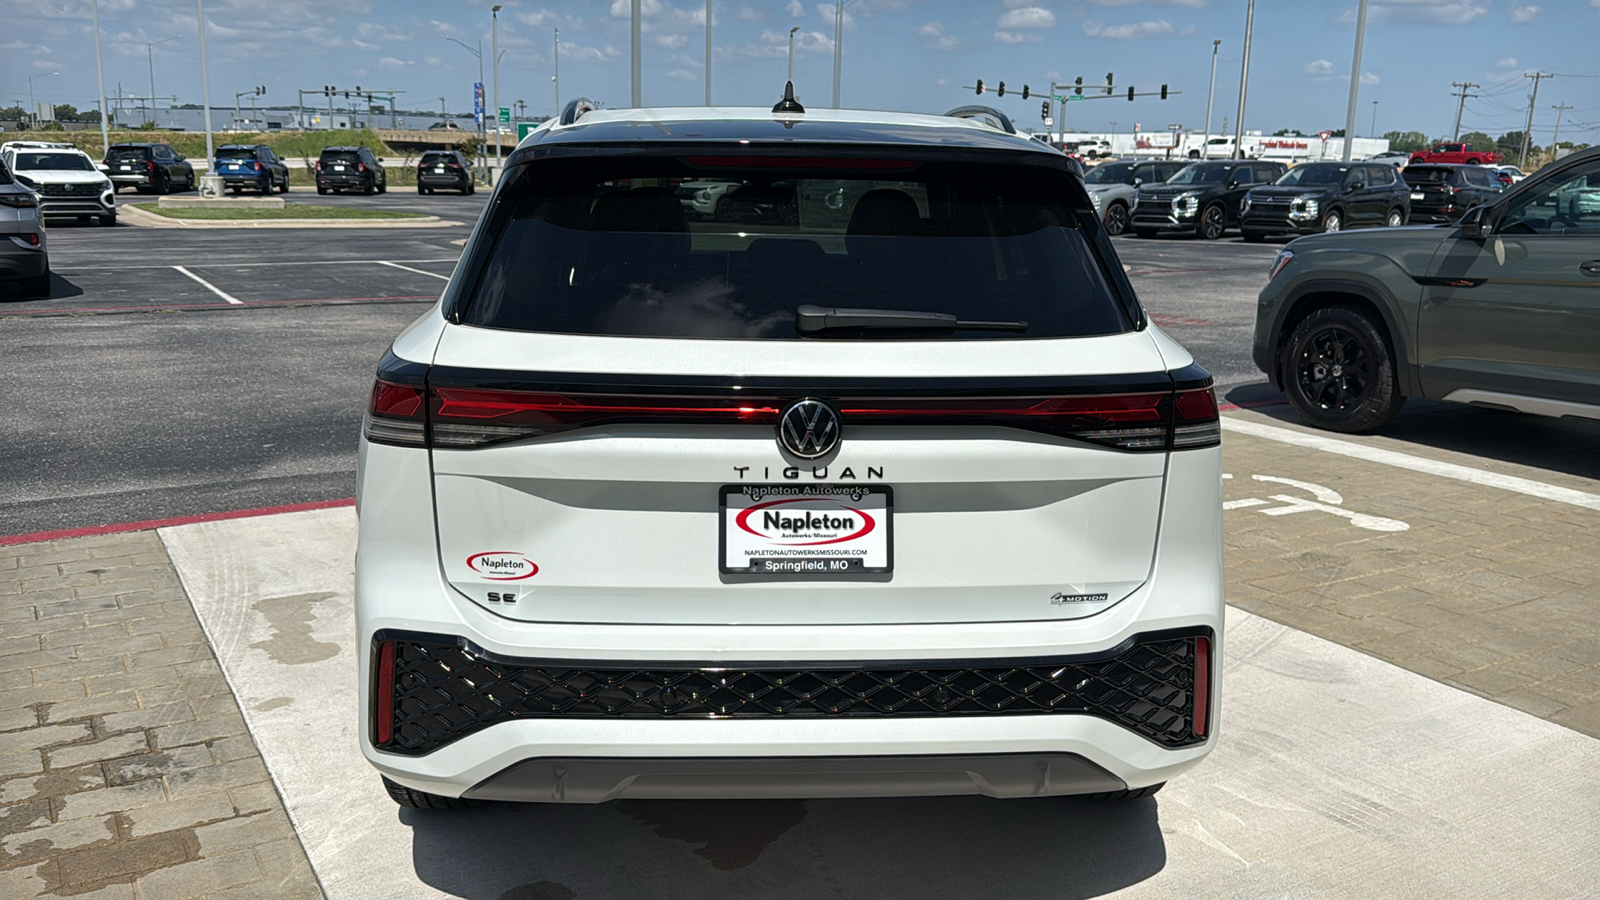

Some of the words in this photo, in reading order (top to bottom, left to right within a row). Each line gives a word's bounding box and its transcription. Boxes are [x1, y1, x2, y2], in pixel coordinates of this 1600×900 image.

[734, 466, 884, 479] TIGUAN
[742, 486, 800, 496] Napleton
[803, 486, 870, 496] Autowerks
[763, 511, 854, 533] Napleton
[744, 549, 868, 557] NAPLETONAUTOWERKSMISSOURI.COM
[481, 557, 524, 569] Napleton
[765, 559, 828, 571] Springfield,
[830, 560, 849, 570] MO
[487, 592, 517, 603] SE
[1051, 592, 1108, 603] 4MOTION
